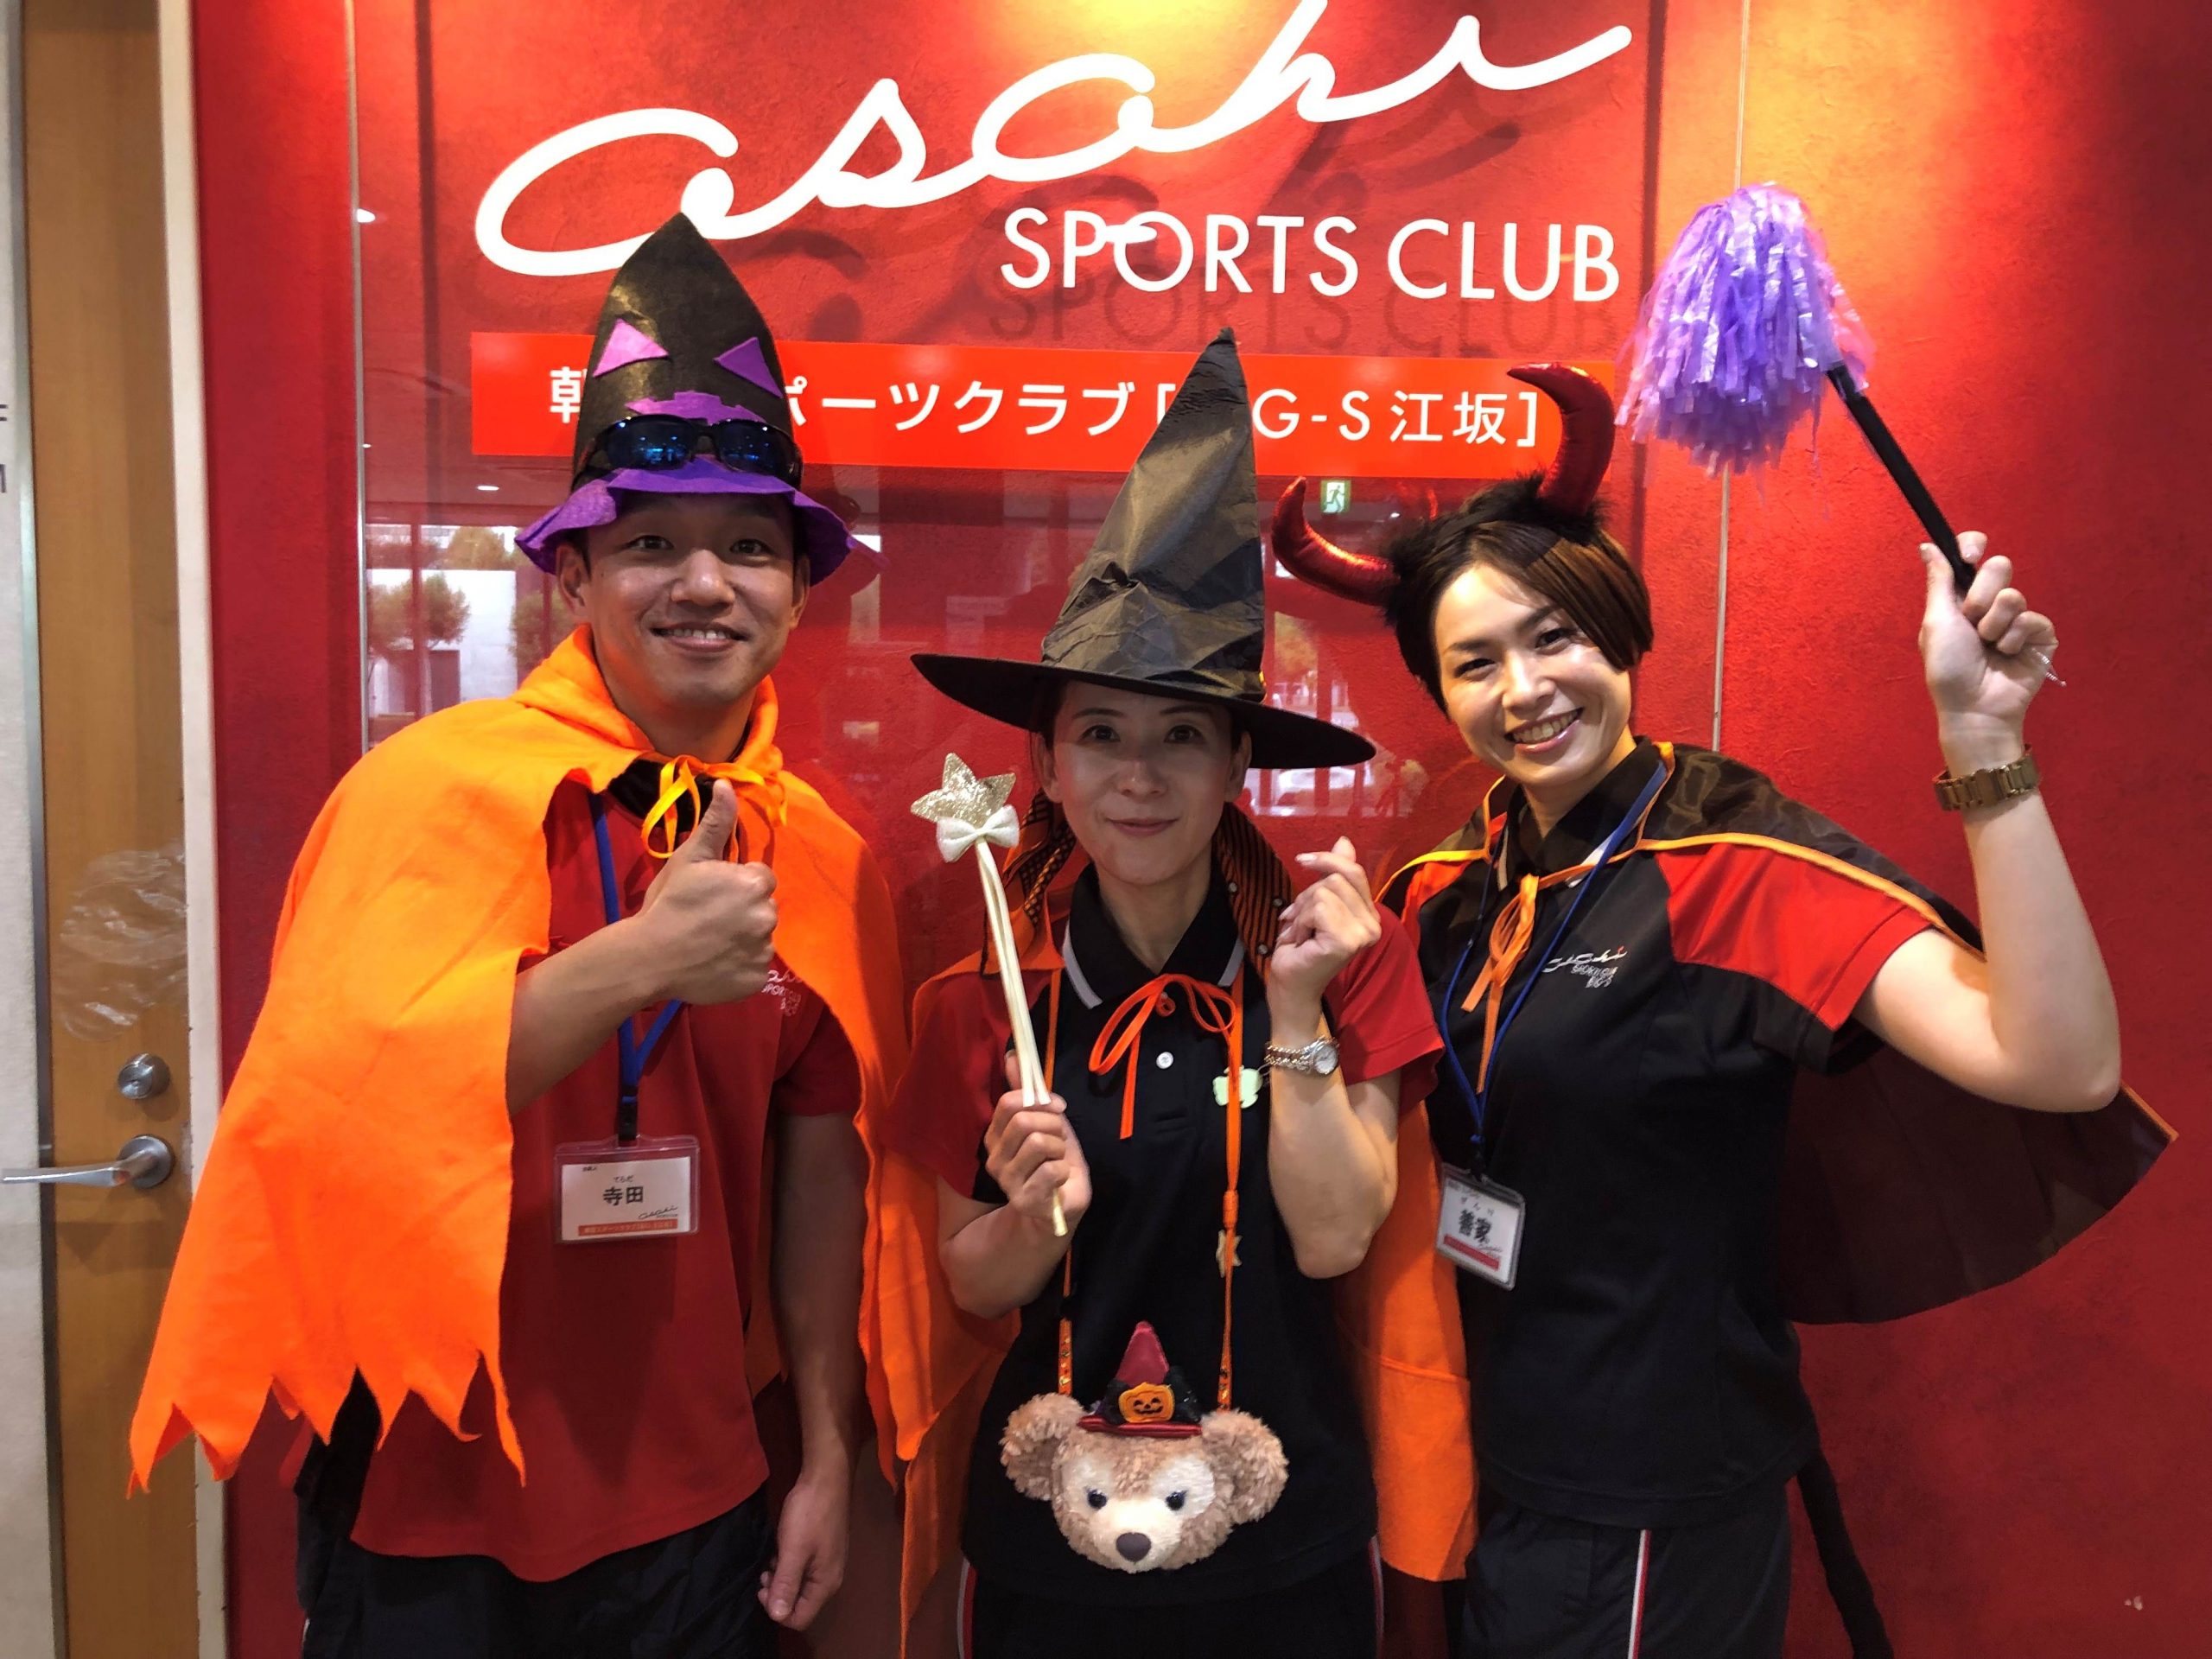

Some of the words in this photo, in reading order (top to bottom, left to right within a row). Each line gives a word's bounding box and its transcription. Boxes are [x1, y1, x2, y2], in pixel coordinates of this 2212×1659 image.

[1000, 207, 1358, 297] SPORTS
[1386, 219, 1620, 302] CLUB
[602, 1185, 644, 1207] 寺田
